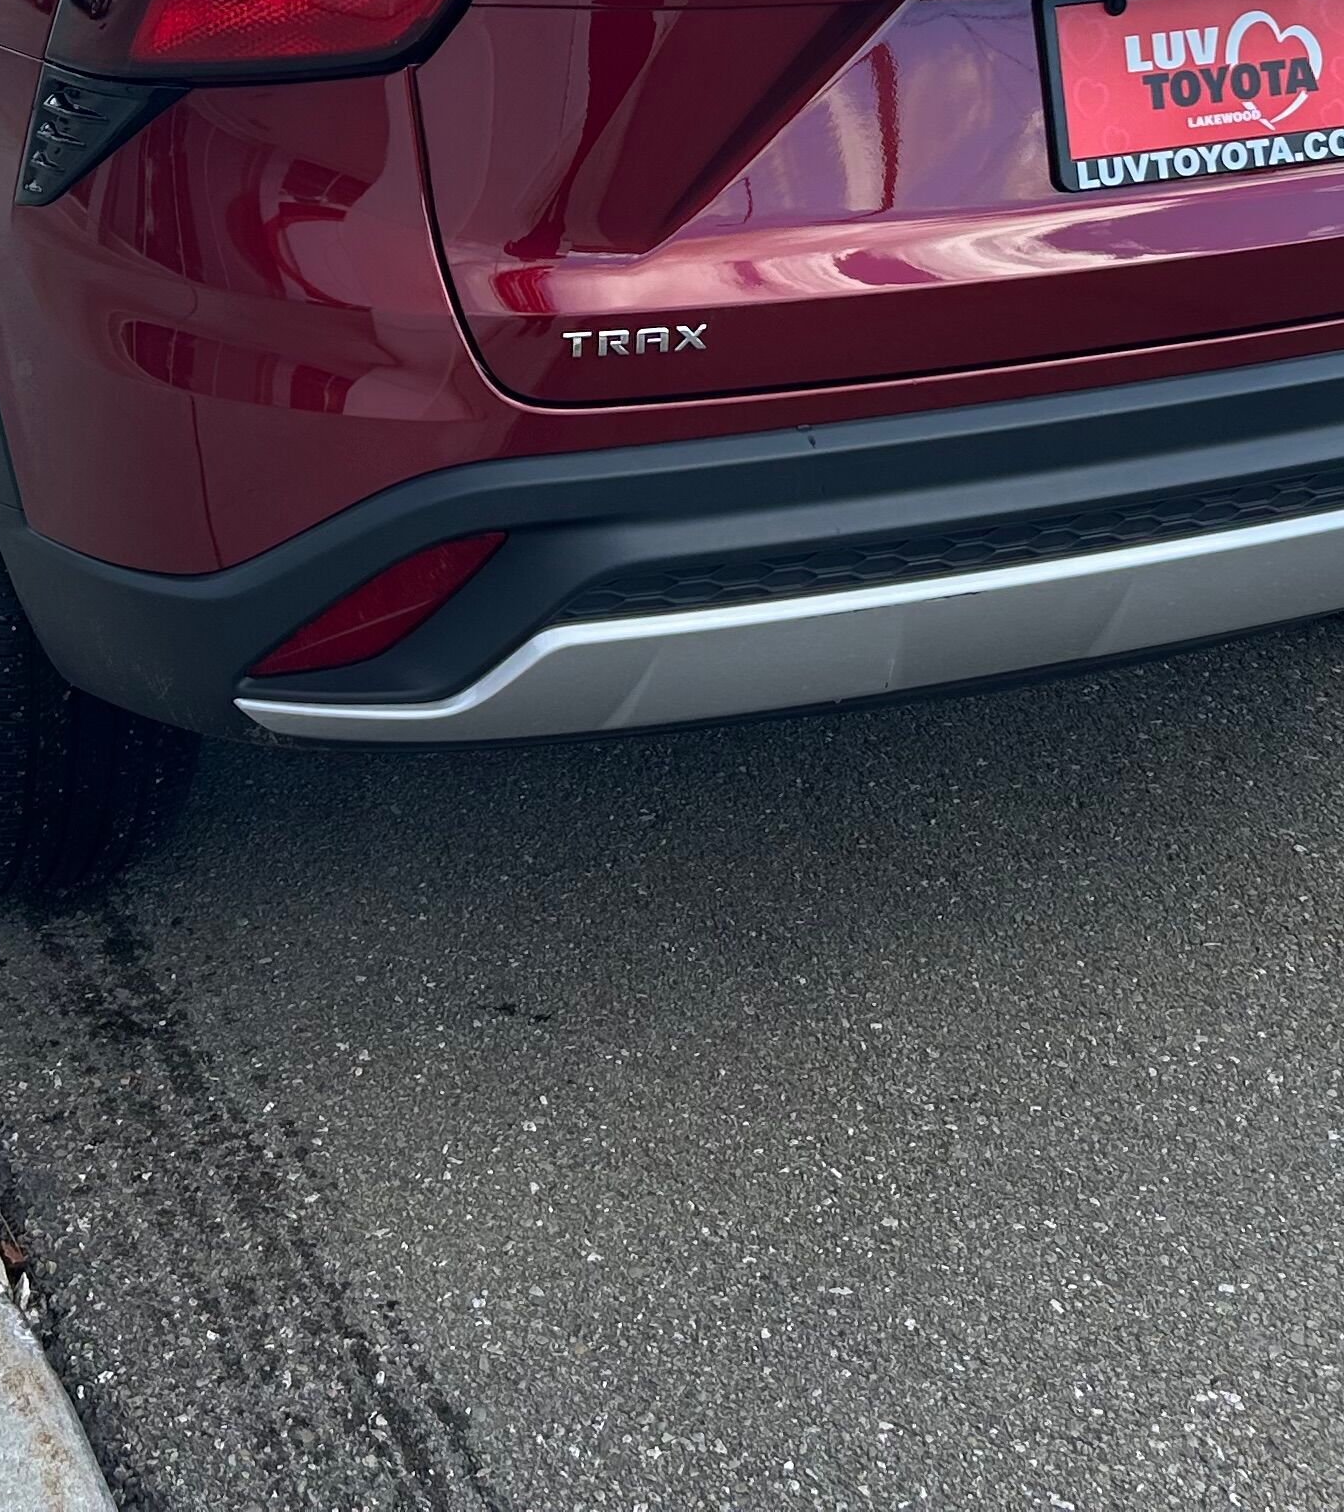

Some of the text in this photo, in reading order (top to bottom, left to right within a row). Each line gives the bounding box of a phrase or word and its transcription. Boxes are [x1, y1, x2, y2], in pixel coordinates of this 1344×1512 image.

[1124, 26, 1219, 73] LUV
[1142, 56, 1319, 111] TOYOTA
[1187, 107, 1262, 129] LAKEWOOD
[562, 323, 708, 358] TRAX
